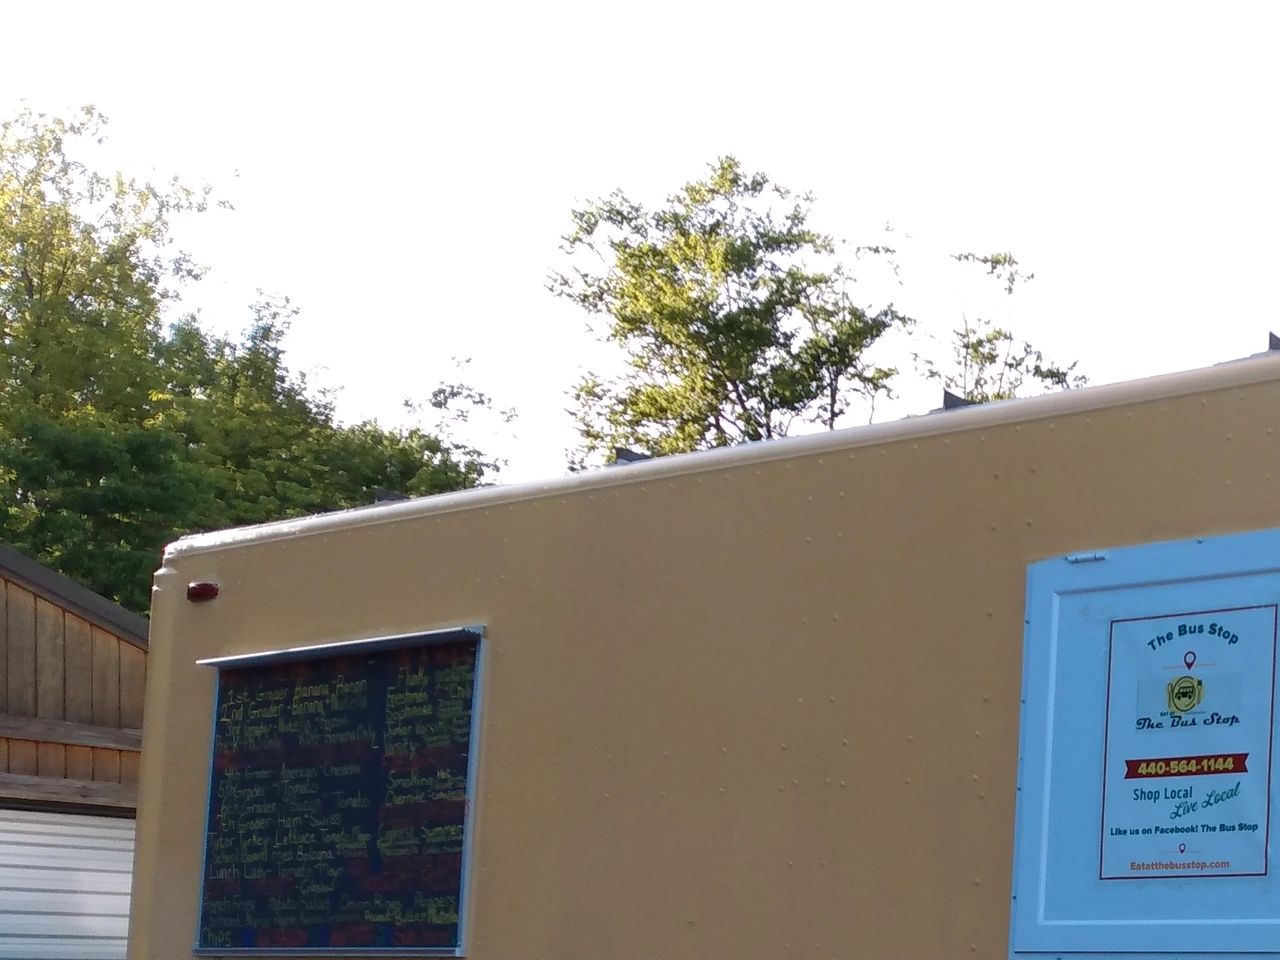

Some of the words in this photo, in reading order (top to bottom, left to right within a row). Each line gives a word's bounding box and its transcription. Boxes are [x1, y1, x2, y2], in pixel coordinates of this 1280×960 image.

[1147, 631, 1174, 651] The
[1178, 623, 1204, 637] Bus
[1208, 622, 1239, 645] Stop
[1136, 717, 1164, 730] The
[1170, 715, 1197, 728] Bus
[1203, 712, 1240, 726] Stop
[1137, 757, 1234, 775] 440-564-1144
[1133, 786, 1160, 803] Shop
[1164, 786, 1193, 800] Local
[1169, 800, 1198, 820] Live
[1201, 781, 1241, 809] Local
[1110, 827, 1128, 836] Like
[1129, 828, 1140, 836] us
[1141, 827, 1152, 835] on
[1154, 824, 1199, 834] Facebook!
[1200, 824, 1218, 833] The
[1219, 823, 1236, 832] Bus
[1238, 822, 1258, 832] Stop
[1130, 860, 1230, 871] Eatatthebusstop.com
